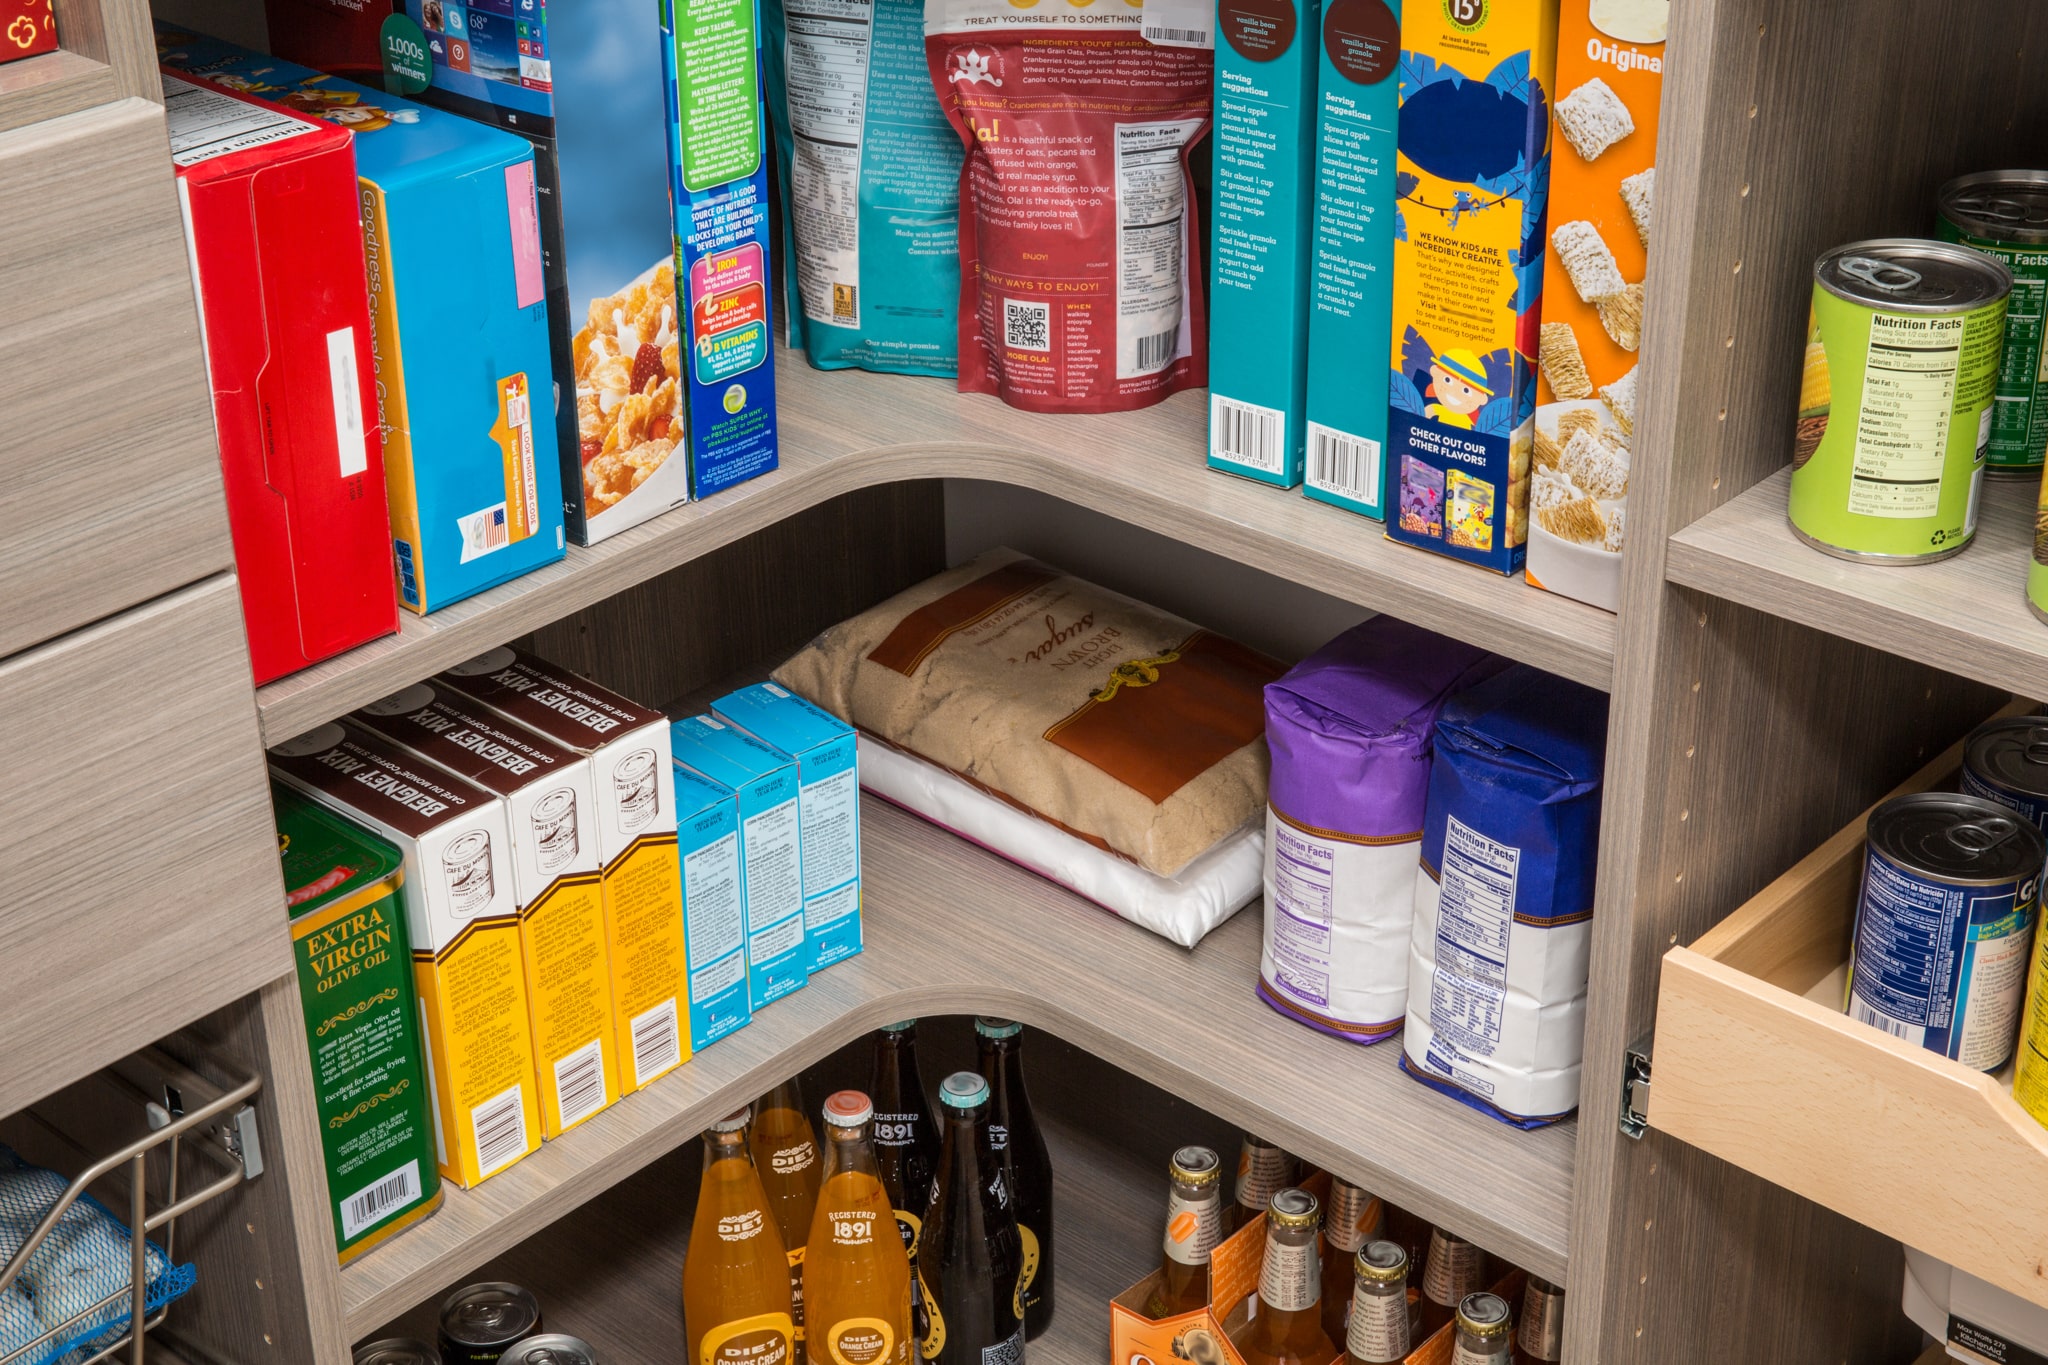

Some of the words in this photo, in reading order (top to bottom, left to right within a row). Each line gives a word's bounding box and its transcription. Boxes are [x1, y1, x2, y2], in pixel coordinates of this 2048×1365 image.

[694, 26, 709, 36] KEEP
[710, 20, 737, 32] TALKING:
[964, 16, 999, 26] TREAT
[1001, 15, 1058, 23] YOURSELF
[1062, 15, 1076, 23] TO
[1236, 16, 1259, 28] vanilla
[1260, 21, 1276, 29] bean
[1243, 26, 1268, 36] granola
[1023, 39, 1079, 47] INGREDIENTS
[1081, 40, 1112, 48] YOU'VE
[403, 56, 410, 66] of
[1587, 38, 1662, 73] Origina
[391, 62, 426, 82] winners
[1222, 70, 1252, 84] Serving
[691, 84, 721, 98] MATCHING
[721, 77, 745, 91] LETTERS
[698, 96, 705, 105] IN
[706, 94, 717, 104] THE
[718, 88, 740, 101] WORLD:
[1222, 82, 1268, 97] suggestions
[1221, 100, 1246, 114] Spread
[1247, 107, 1268, 117] apple
[1325, 92, 1355, 108] Serving
[1325, 103, 1372, 121] suggestions
[234, 125, 311, 147] Nutrition
[1018, 135, 1056, 144] healthful
[1058, 135, 1081, 144] snack
[1083, 135, 1093, 143] of
[1120, 130, 1156, 138] Nutrition
[1159, 127, 1181, 135] Facts
[181, 146, 232, 162] Facts
[1015, 146, 1024, 156] of
[1026, 148, 1046, 157] oats,
[1048, 148, 1077, 157] pecans
[1079, 148, 1096, 156] and
[994, 159, 1025, 168] infused
[1027, 160, 1045, 169] with
[1047, 161, 1078, 170] orange,
[1006, 172, 1022, 180] real
[1024, 172, 1050, 182] maple
[1052, 172, 1077, 183] syrup.
[739, 185, 756, 197] GOOD
[692, 210, 715, 222] SOURCE
[716, 207, 724, 215] OF
[725, 196, 757, 212] NUTRIENTS
[1007, 196, 1024, 205] Ola!
[1026, 196, 1032, 205] is
[1033, 197, 1049, 205] the
[1051, 196, 1103, 208] ready-to-go,
[688, 231, 711, 244] BLOCKS
[712, 227, 724, 237] FOR
[725, 222, 742, 234] YOUR
[743, 213, 764, 226] CHILD'S
[696, 220, 713, 231] THAT
[714, 216, 726, 226] ARE
[727, 207, 754, 221] BUILDING
[363, 189, 382, 293] Goodness
[697, 235, 735, 252] DEVELOPING
[736, 228, 755, 241] BRAIN:
[1219, 225, 1248, 239] Sprinkle
[1249, 234, 1277, 245] granola
[1420, 232, 1431, 240] WE
[1433, 235, 1459, 247] KNOW
[1461, 242, 1479, 252] KIDS
[1482, 248, 1498, 256] ARE
[1414, 240, 1460, 257] INCREDIBLY
[1462, 252, 1504, 267] CREATIVE.
[2014, 253, 2048, 265] Facts
[716, 257, 738, 273] IRON
[1005, 279, 1034, 289] WAYS
[1037, 282, 1052, 291] TO
[1056, 282, 1099, 292] ENJOY!
[720, 296, 740, 313] ZINC
[1420, 300, 1436, 310] Visit
[1874, 315, 1926, 330] Nutrition
[1930, 320, 1962, 330] Facts
[714, 341, 721, 353] B
[721, 329, 759, 351] VITAMINS
[865, 339, 880, 347] Our
[1007, 351, 1028, 361] MORE
[711, 420, 729, 431] Watch
[729, 412, 748, 426] SUPER
[749, 407, 763, 420] WHY!
[1862, 408, 1894, 417] Cholesterol
[523, 431, 532, 454] LOOK
[1410, 426, 1441, 444] CHECK
[1442, 436, 1462, 449] OUT
[1463, 442, 1486, 456] OUR
[1873, 440, 1911, 449] Carbohydrate
[1408, 437, 1439, 455] OTHER
[1441, 447, 1487, 467] FLAVORS!
[525, 457, 533, 482] INSIDE
[1855, 466, 1875, 475] Protein
[529, 502, 537, 524] CODE
[1025, 611, 1094, 664] sugar
[1051, 626, 1122, 671] BROWN
[490, 669, 539, 693] MIX
[408, 708, 457, 734] MIX
[527, 689, 621, 734] BEIGNET
[315, 749, 367, 775] MIX
[444, 729, 539, 776] BEIGNET
[353, 769, 450, 818] BEIGNET
[431, 785, 443, 794] DU
[1277, 828, 1305, 852] Nutrition
[1308, 845, 1332, 860] Facts
[1450, 821, 1485, 850] Nutrition
[1488, 843, 1515, 862] Facts
[307, 907, 384, 958] EXTRA
[310, 924, 391, 977] VIRGIN
[317, 962, 361, 993] OLIVE
[364, 950, 390, 969] OIL
[325, 1082, 354, 1103] Excellent
[354, 1075, 364, 1085] for
[364, 1067, 386, 1080] salads,
[386, 1055, 406, 1069] frying
[349, 1086, 362, 1098] fine
[362, 1073, 390, 1092] cooking.
[874, 1113, 919, 1121] EGISTERED
[874, 1122, 913, 1140] 1891
[772, 1148, 815, 1168] DIET
[718, 1215, 763, 1234] DIET
[828, 1211, 877, 1222] REGISTERED
[834, 1221, 872, 1238] 1891
[840, 1341, 863, 1350] ORANGE
[863, 1339, 883, 1350] CREAM
[844, 1334, 878, 1342] DIET
[1957, 1322, 1973, 1335] Max
[1974, 1330, 1993, 1344] Watts
[1993, 1340, 2006, 1350] 275
[1960, 1332, 2002, 1356] KitchenAid
[725, 1337, 778, 1357] DIET
[757, 1344, 786, 1365] CREAM
